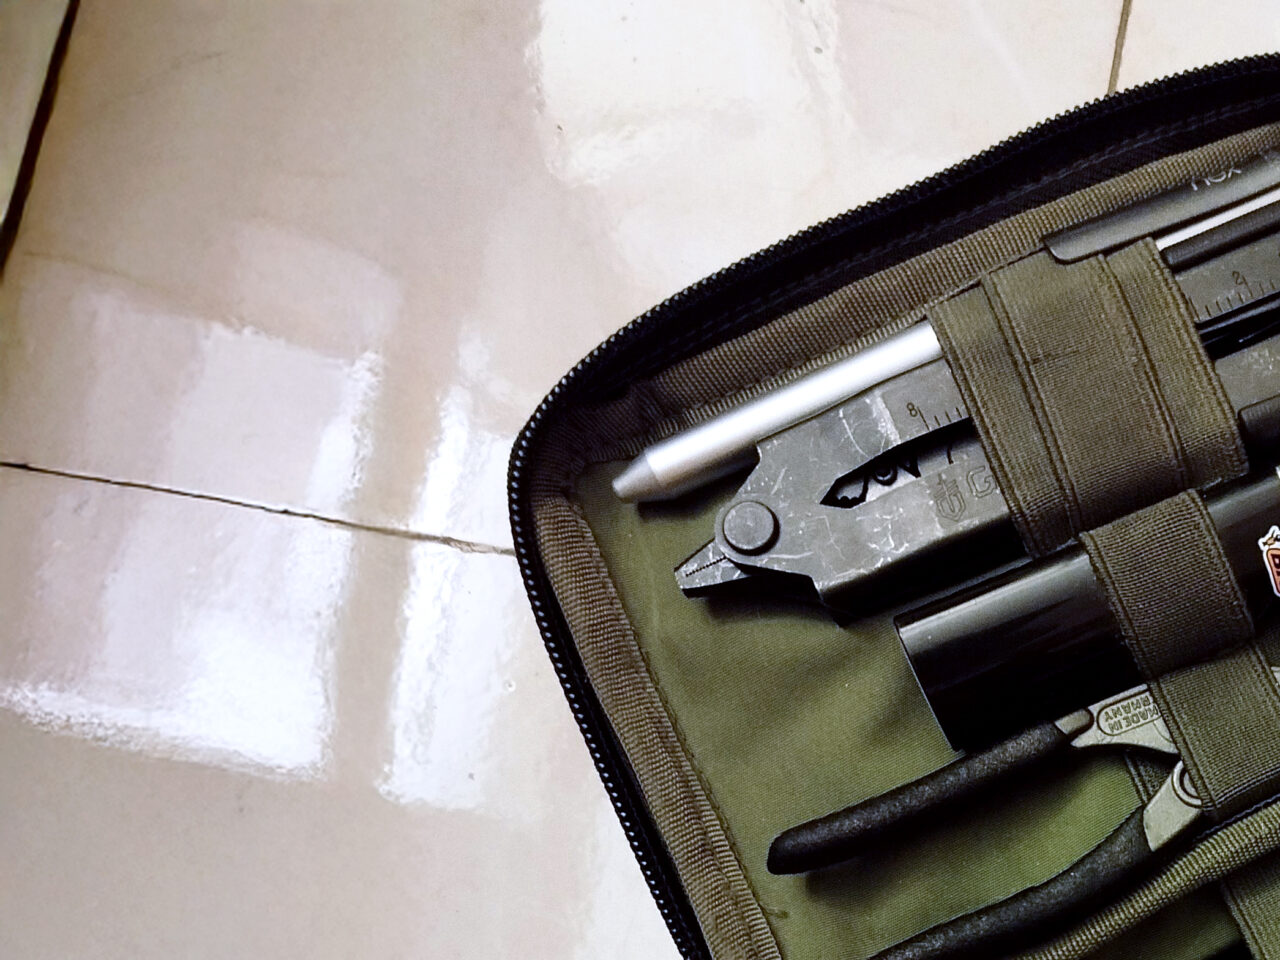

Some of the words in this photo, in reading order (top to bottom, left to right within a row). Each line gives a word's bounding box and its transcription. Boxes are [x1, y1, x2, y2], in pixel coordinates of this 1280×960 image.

[906, 402, 919, 418] 8
[1123, 704, 1159, 728] MADE
[1107, 719, 1124, 734] IN
